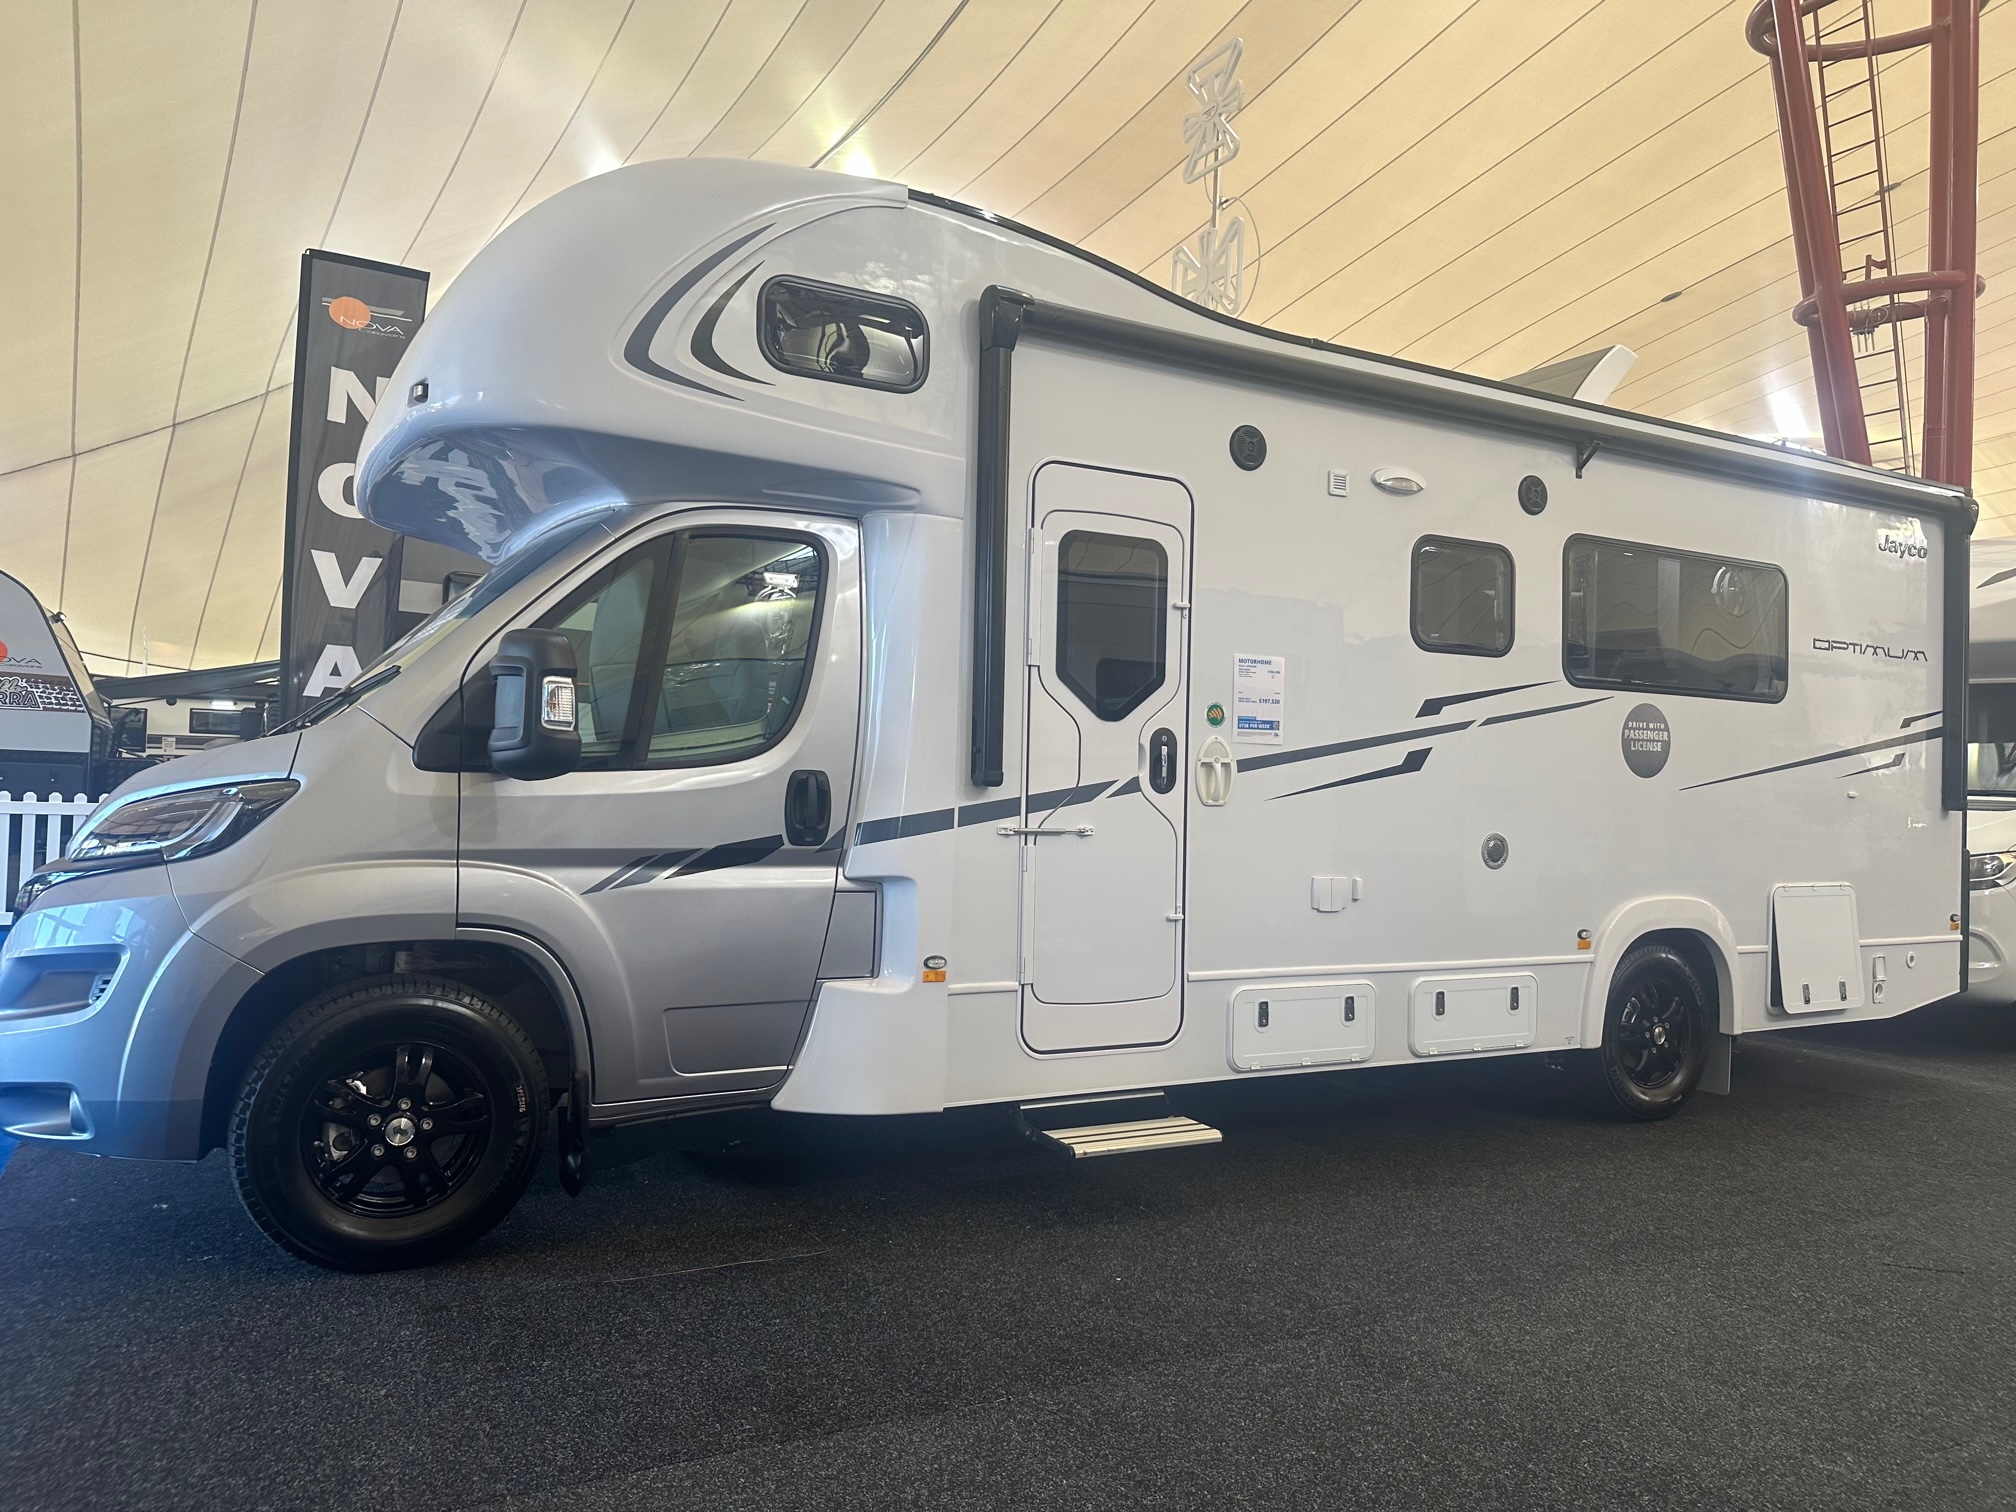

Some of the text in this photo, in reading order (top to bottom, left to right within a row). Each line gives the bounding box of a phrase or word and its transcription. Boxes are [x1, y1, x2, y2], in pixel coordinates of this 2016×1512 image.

[340, 316, 404, 335] NOVA
[1878, 534, 1928, 559] Jayco
[1813, 637, 1928, 662] OPTIMUM
[0, 655, 42, 665] OVA
[0, 690, 41, 709] RRA
[1628, 721, 1647, 729] DRIVE
[1624, 729, 1669, 741] PASSENGER
[1630, 741, 1662, 752] LICENSE
